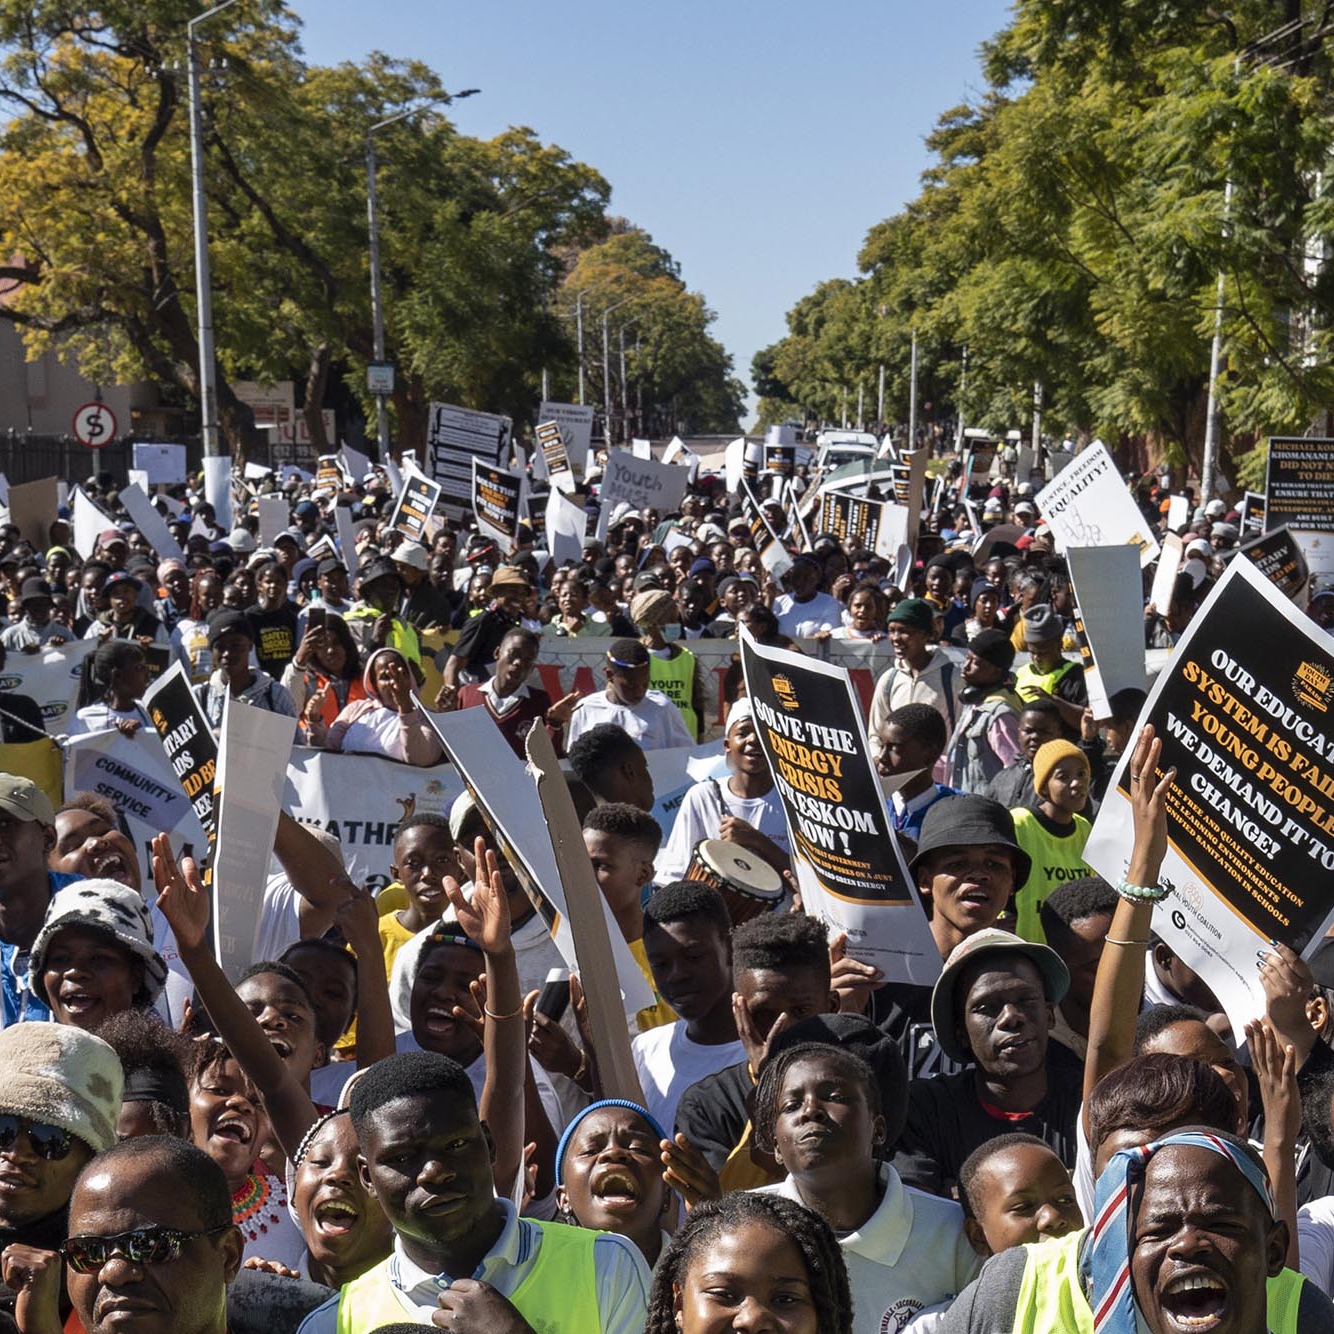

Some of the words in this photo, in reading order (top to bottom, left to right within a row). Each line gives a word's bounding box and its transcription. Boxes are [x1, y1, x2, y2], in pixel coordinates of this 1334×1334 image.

[1070, 448, 1104, 481] FREEDOM
[1271, 451, 1328, 460] KHOMANANI
[1274, 442, 1316, 451] MICHAEL
[1279, 461, 1299, 469] DID
[1301, 461, 1325, 470] NOT
[1048, 459, 1108, 519] EQUALITY!
[1297, 471, 1312, 480] TO
[1311, 490, 1334, 498] THAT
[1211, 648, 1255, 693] OUR
[1301, 664, 1327, 685] YOUTH
[1304, 673, 1319, 687] DAY
[753, 696, 806, 743] SOLVE
[806, 721, 858, 756] THE
[1182, 660, 1270, 743] SYSTEM
[1264, 727, 1292, 762] IS
[768, 729, 844, 779] ENERGY
[1191, 699, 1260, 771] YOUNG
[95, 757, 177, 803] COMMUNITY
[778, 759, 843, 804] CRISIS
[1166, 711, 1197, 753] WE
[1193, 740, 1283, 826] DEMAND
[1279, 817, 1311, 847] IT
[93, 782, 152, 818] SERVICE
[1189, 772, 1283, 861] CHANGE!
[796, 815, 837, 852] NOW
[1165, 791, 1181, 808] AFE
[1180, 805, 1219, 846] LEARNING
[1217, 839, 1282, 905] ENVIRONMENTS
[1182, 791, 1204, 818] FREE
[1202, 814, 1221, 834] AND
[1219, 829, 1256, 868] QUALITY
[1254, 861, 1306, 909] EDUCATION
[827, 854, 871, 870] GOVERNMENT
[835, 874, 857, 887] GREEN
[856, 879, 886, 891] ENERGY
[1165, 801, 1197, 838] GNIFIED
[1195, 834, 1244, 885] SANITATION
[1241, 880, 1254, 894] IN
[1251, 889, 1291, 928] SCHOOLS
[1196, 912, 1224, 941] COALITION
